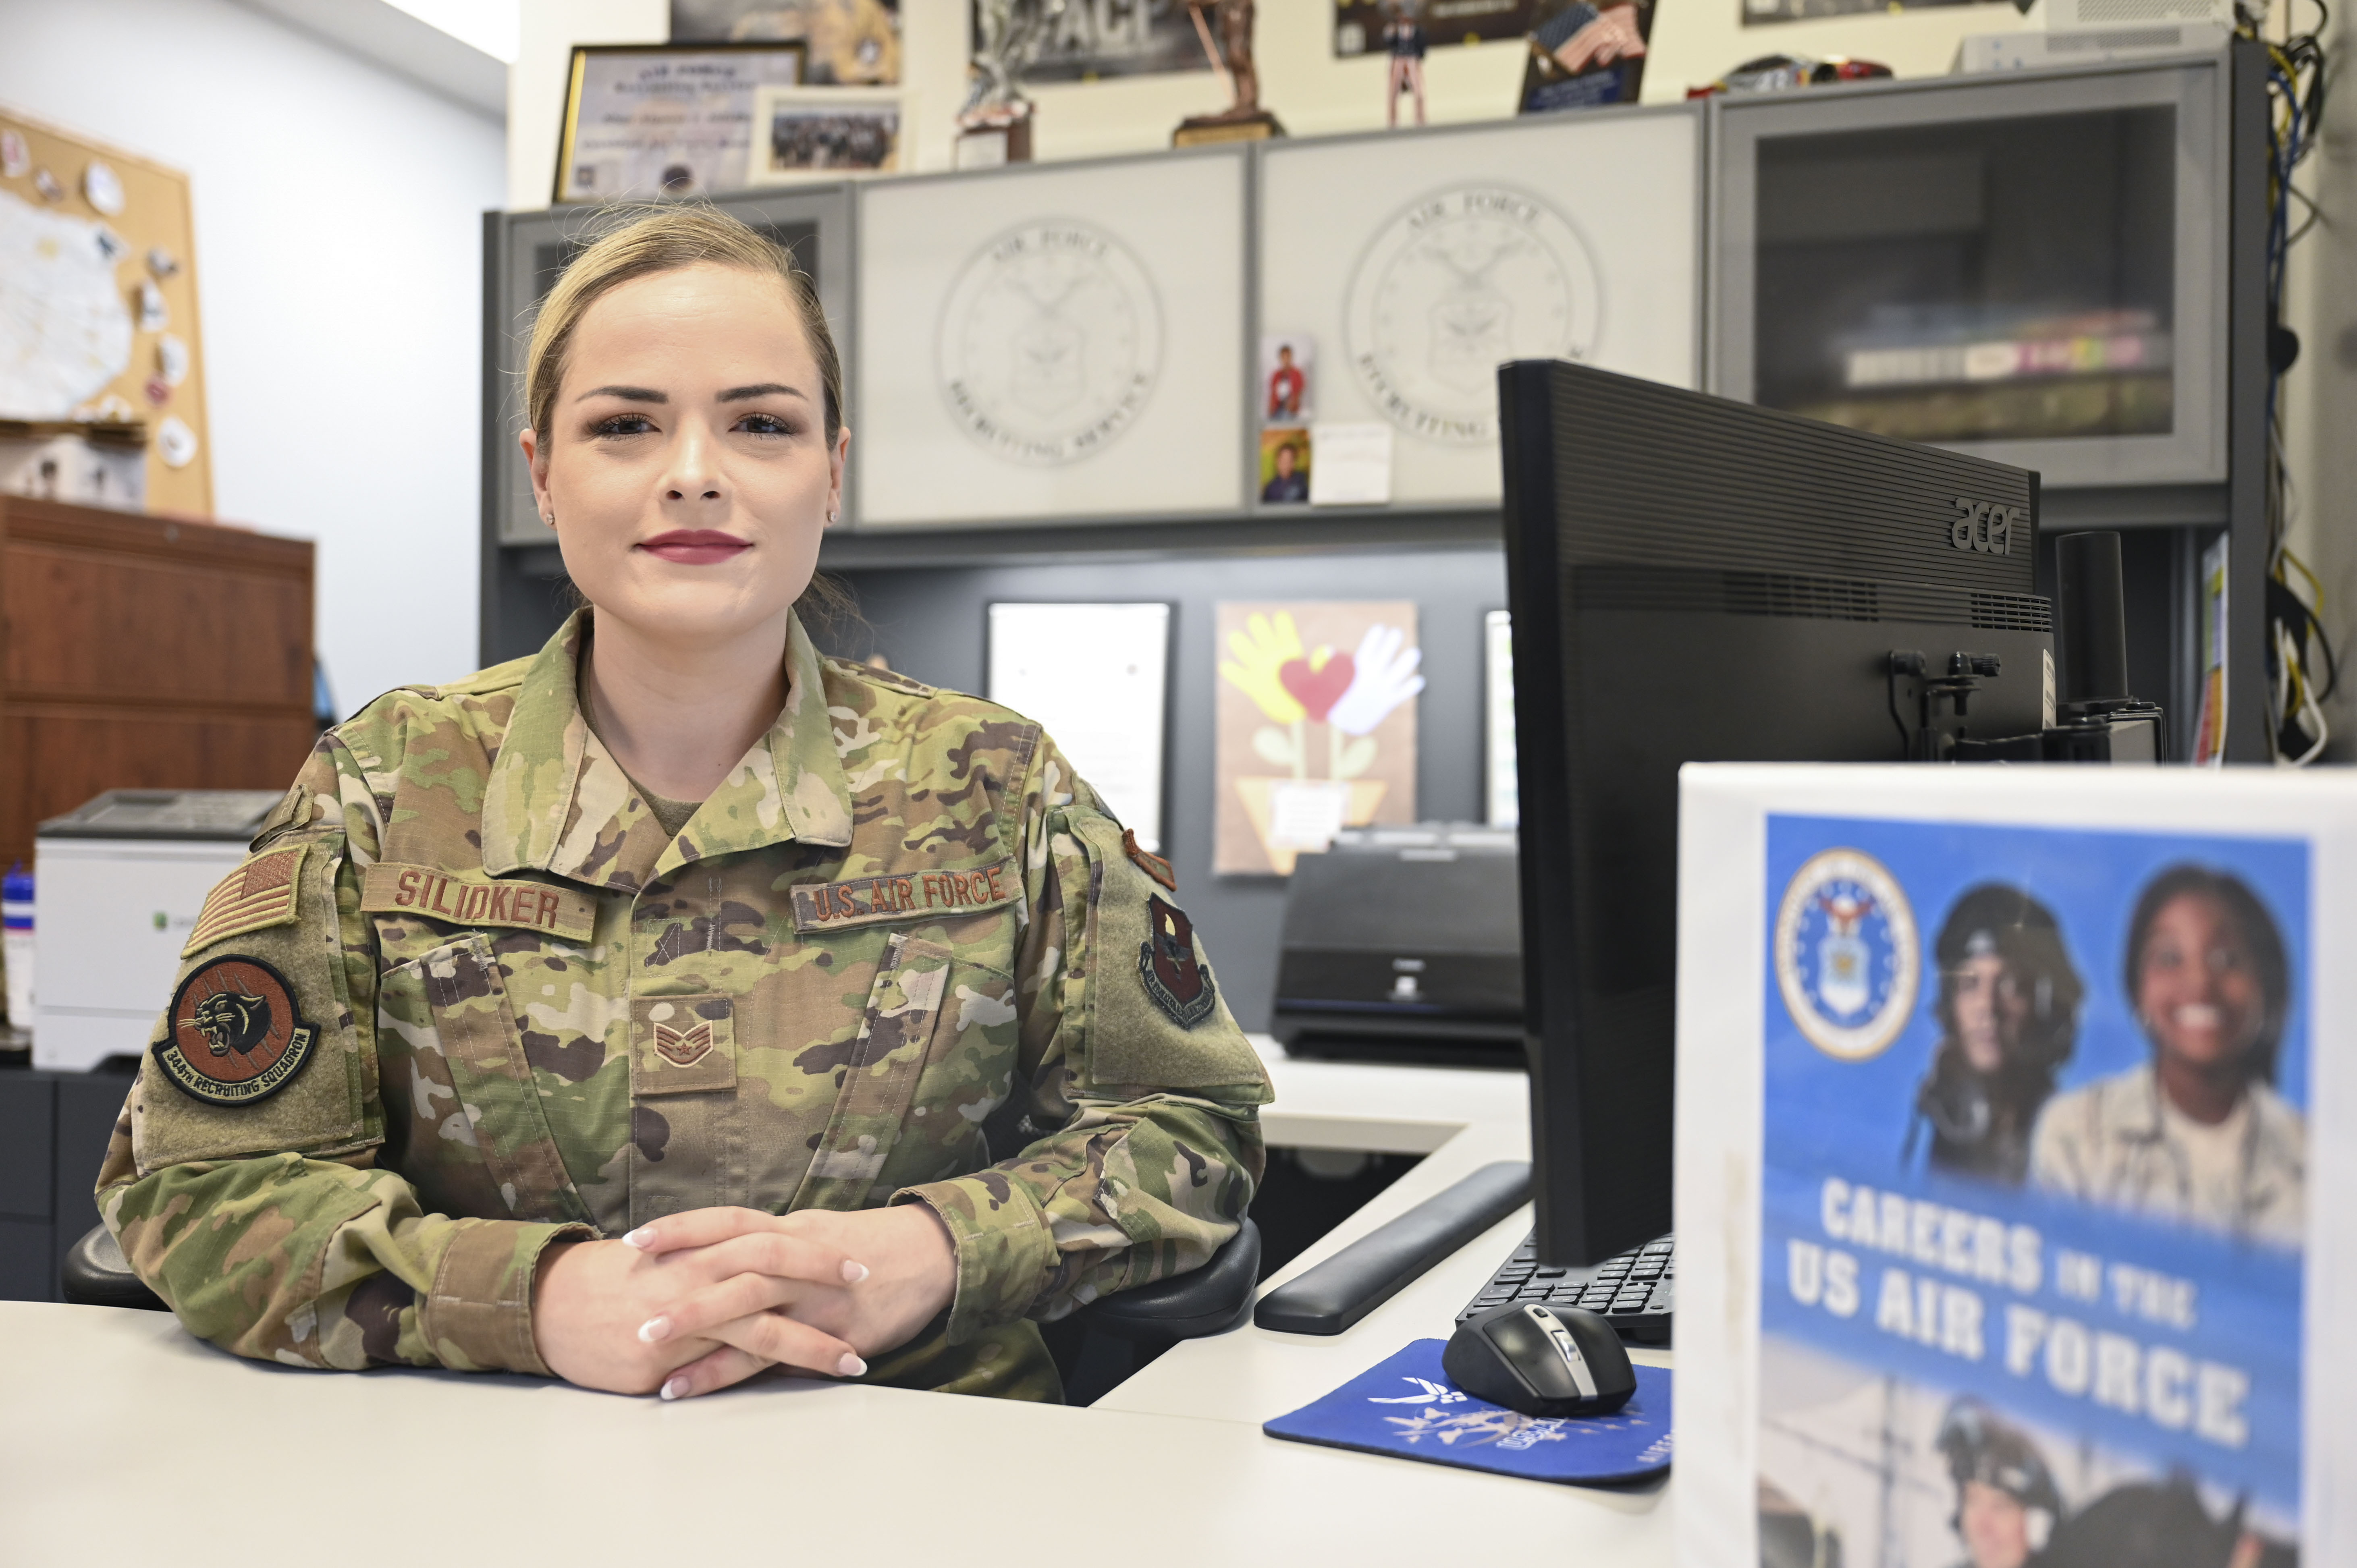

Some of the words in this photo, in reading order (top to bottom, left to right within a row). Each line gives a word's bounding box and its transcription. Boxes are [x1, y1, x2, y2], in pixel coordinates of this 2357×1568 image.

[1951, 497, 2020, 556] acer
[812, 885, 865, 922] U.S.
[871, 878, 916, 913] AIR
[922, 867, 1006, 908] FORCE
[193, 1076, 260, 1097] RECRUITING
[262, 1032, 308, 1087] SQUADRON
[1821, 1177, 2042, 1293] CAREERS
[2056, 1249, 2102, 1302] IN
[2107, 1262, 2197, 1329] THE
[1787, 1238, 1859, 1317] US
[1876, 1268, 1985, 1361] AIR
[2005, 1303, 2250, 1448] FORCE
